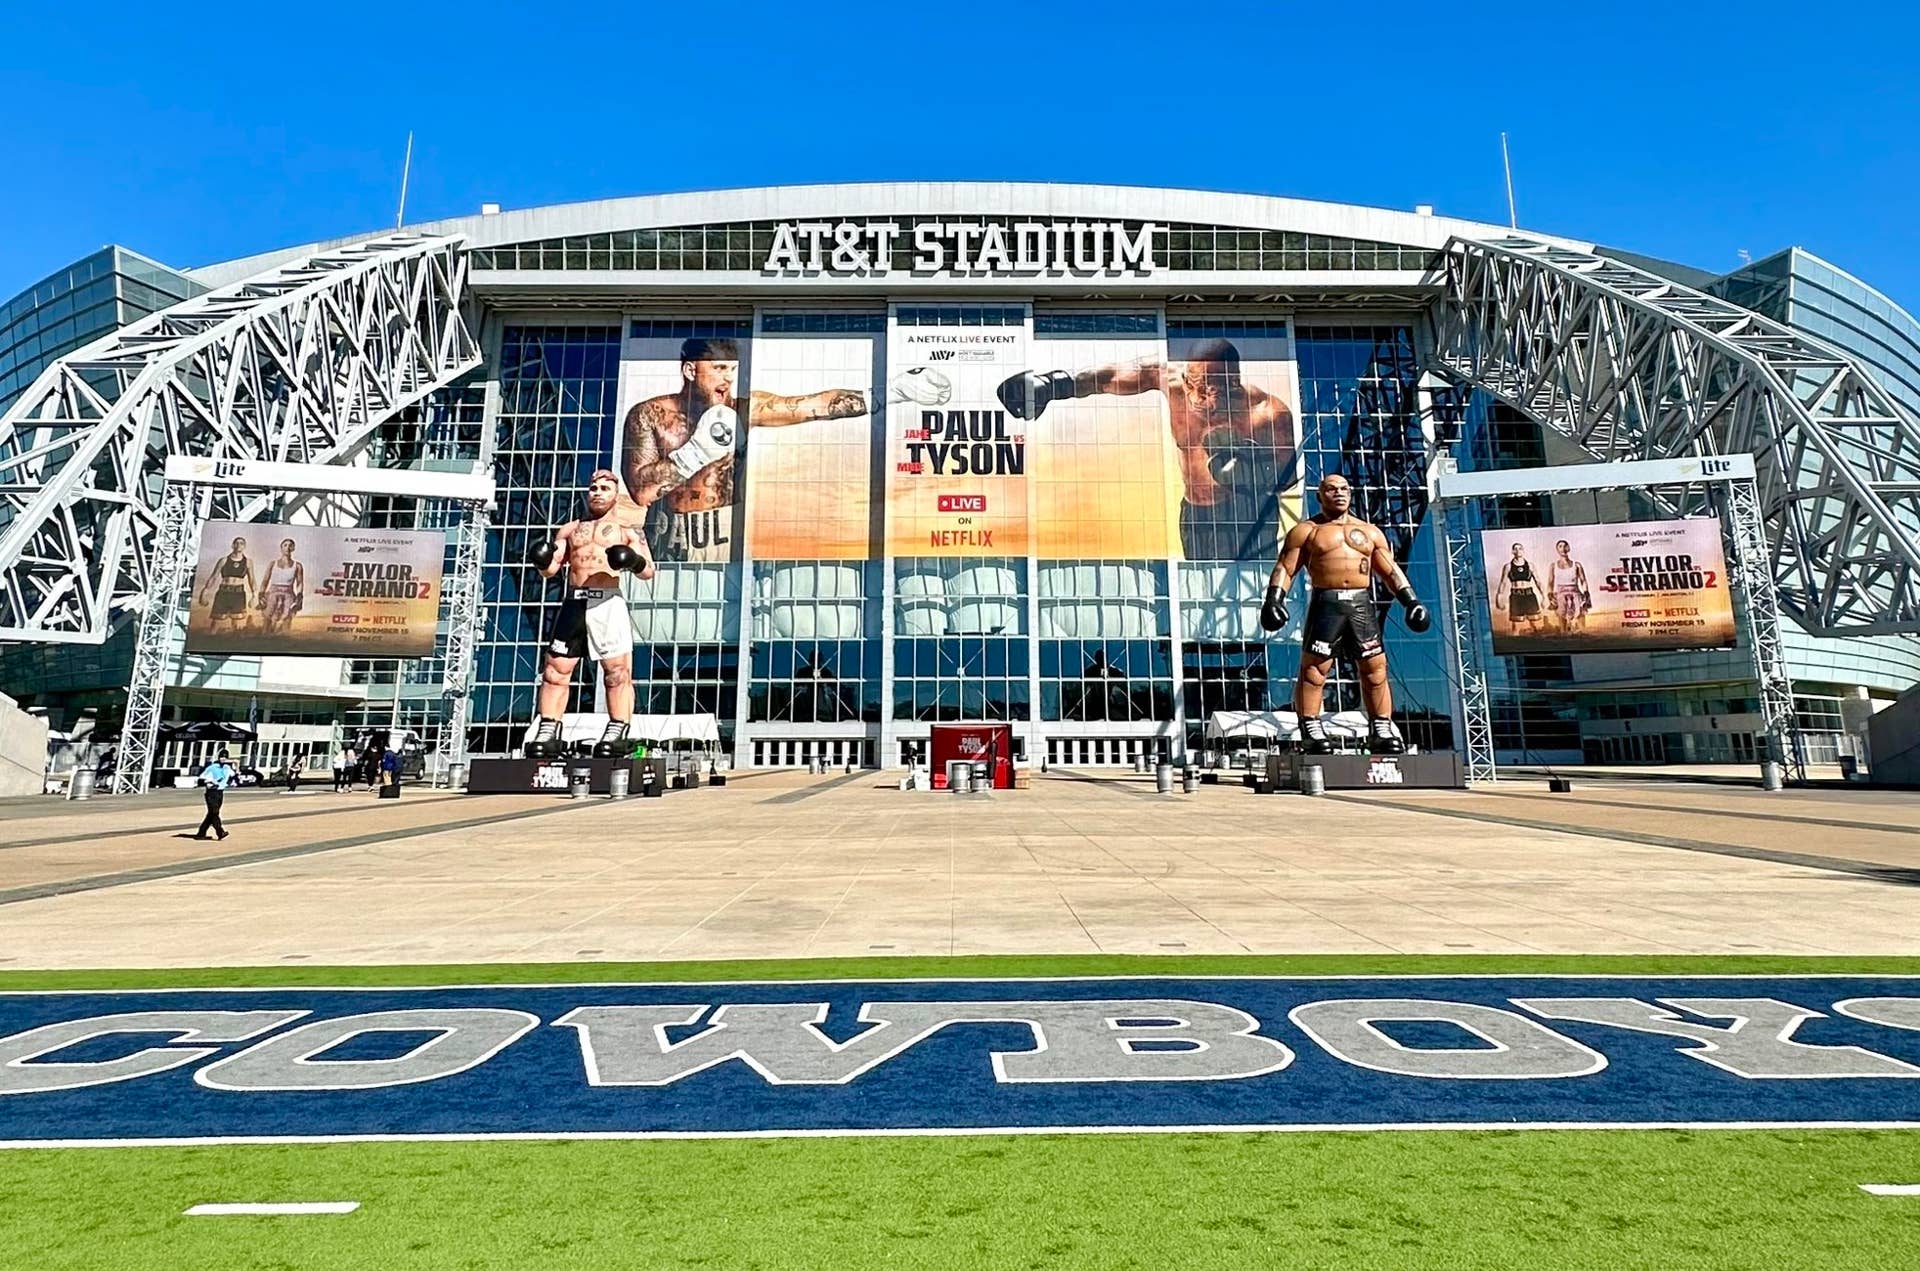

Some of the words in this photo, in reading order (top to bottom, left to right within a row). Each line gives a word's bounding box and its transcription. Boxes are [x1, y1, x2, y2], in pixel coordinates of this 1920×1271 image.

[764, 223, 900, 271] AT&T
[914, 223, 1157, 271] STADIUM
[921, 410, 1011, 442] PAUL
[1014, 434, 1025, 442] VS
[906, 443, 1025, 475] TYSON
[213, 461, 245, 478] Lite
[1700, 460, 1730, 476] Lite
[951, 497, 981, 509] LIVE
[653, 509, 729, 549] PAUL
[958, 517, 972, 525] ON
[931, 530, 993, 547] NETFLIX
[342, 562, 412, 580] TAYLOR
[1620, 555, 1693, 573] TAYLOR
[322, 579, 418, 599] SERRANO
[418, 582, 431, 600] 2
[1605, 571, 1703, 592] SERRANO
[1704, 570, 1717, 588] 2
[373, 615, 407, 625] NETFLIX
[1664, 607, 1700, 617] NETFLIX
[958, 745, 987, 754] TYSO
